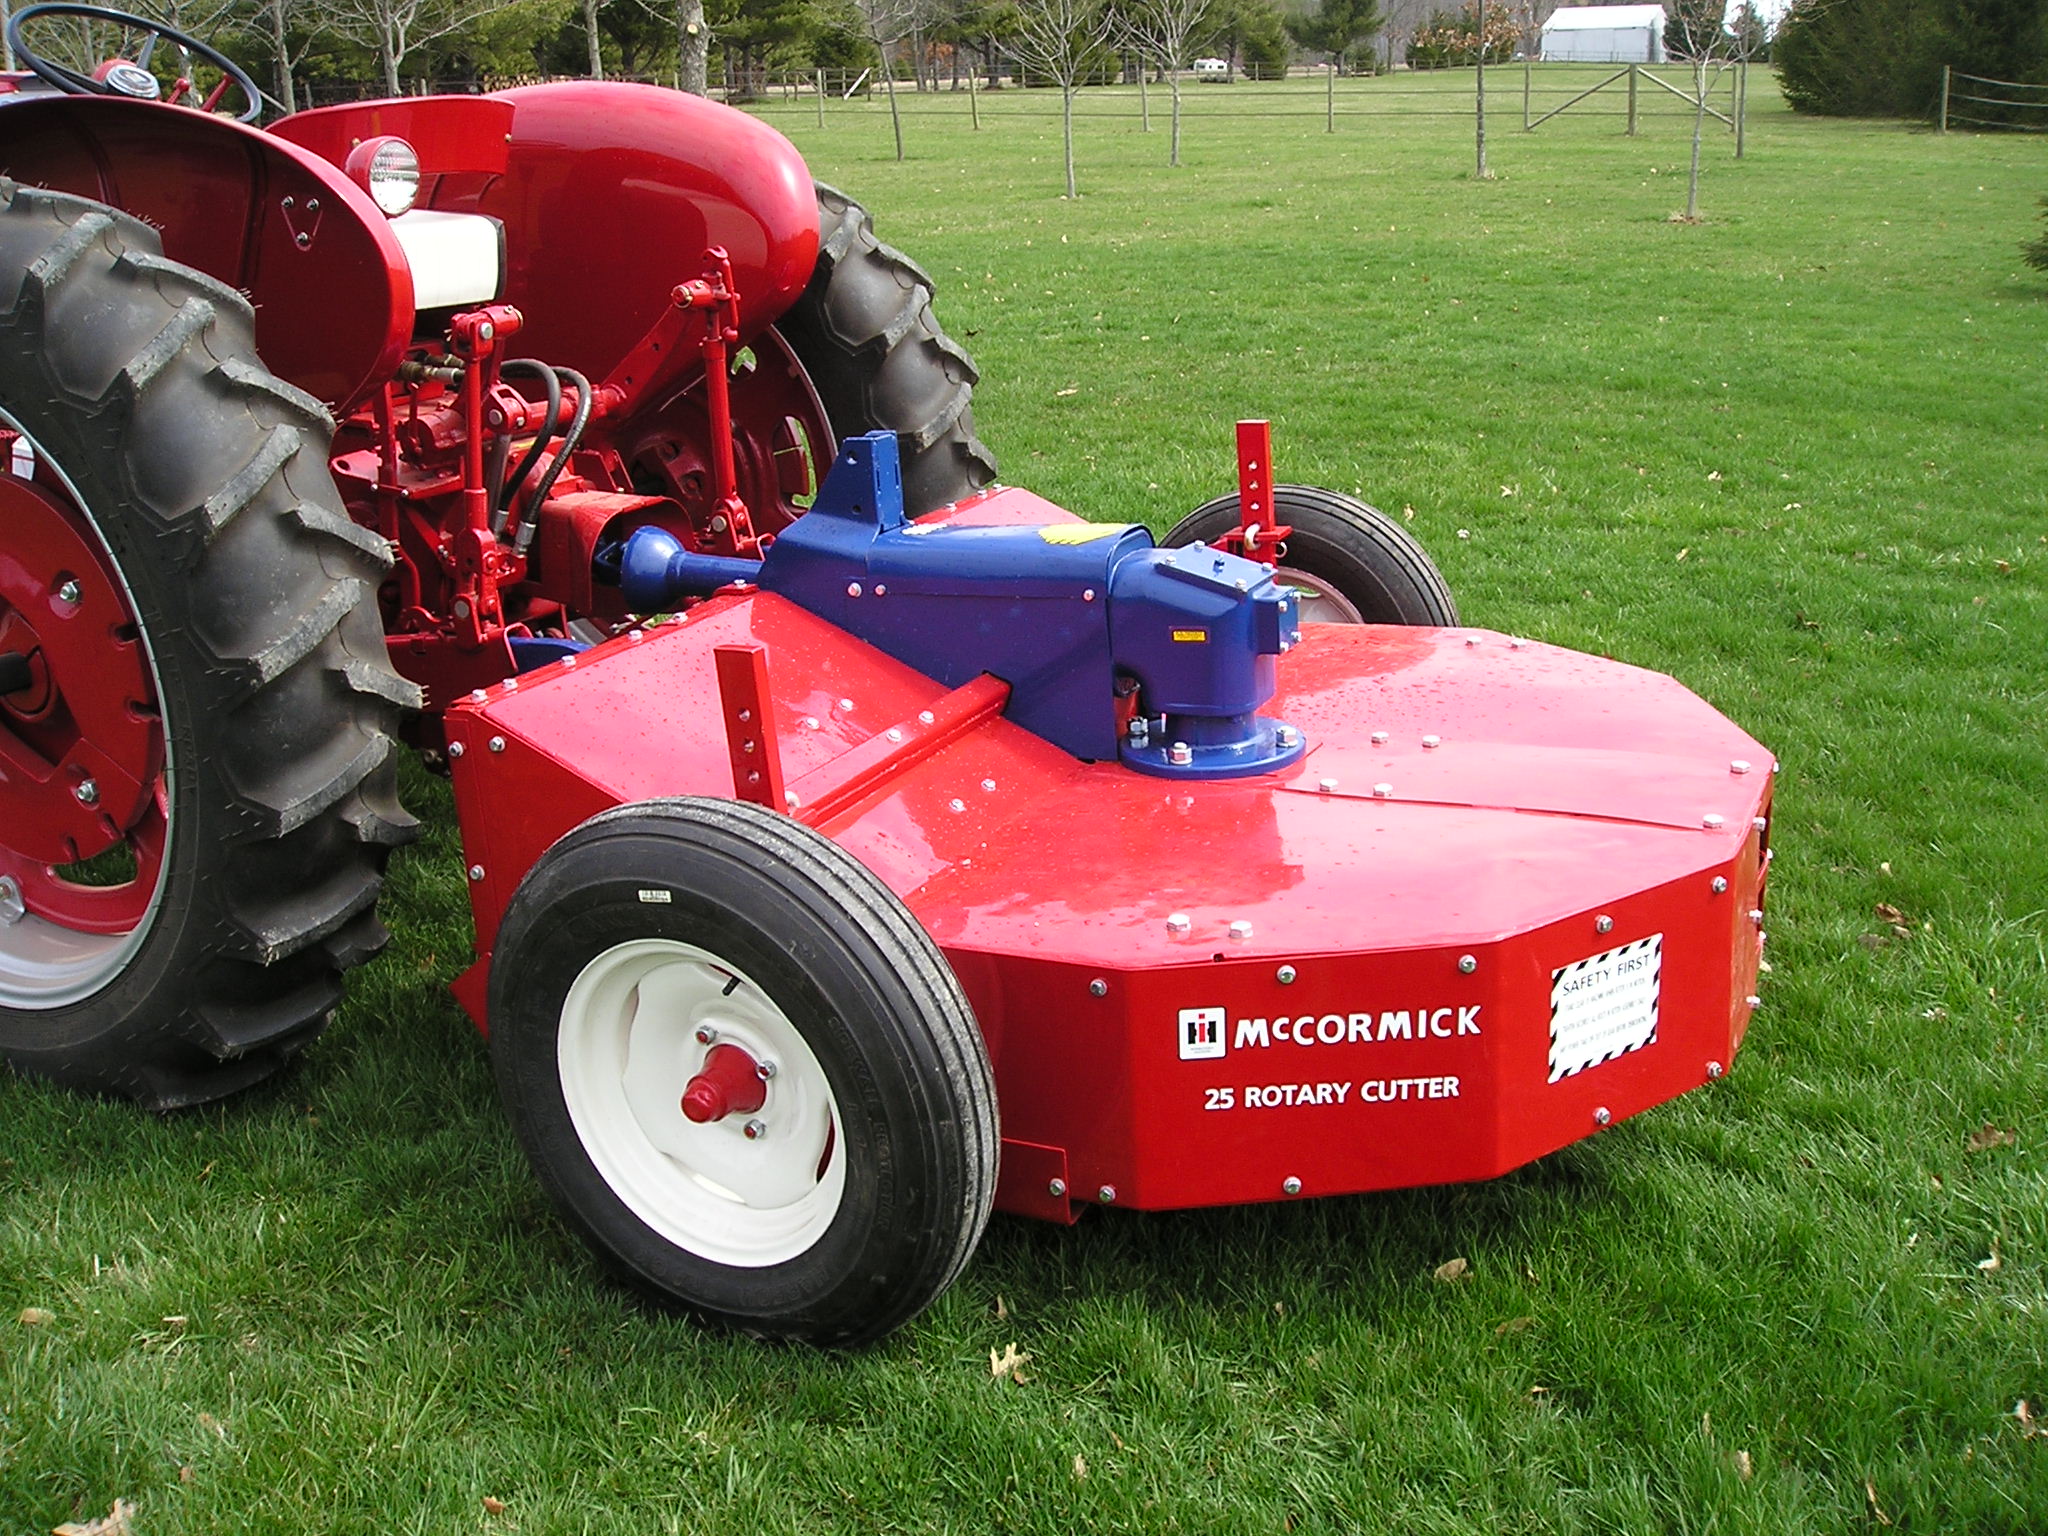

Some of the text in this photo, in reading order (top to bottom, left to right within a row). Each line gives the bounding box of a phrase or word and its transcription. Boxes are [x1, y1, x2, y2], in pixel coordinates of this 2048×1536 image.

[1562, 968, 1612, 997] SAFETY
[1617, 954, 1651, 976] FIRST
[1203, 1076, 1460, 1111] 25 ROTARY CUTTER
